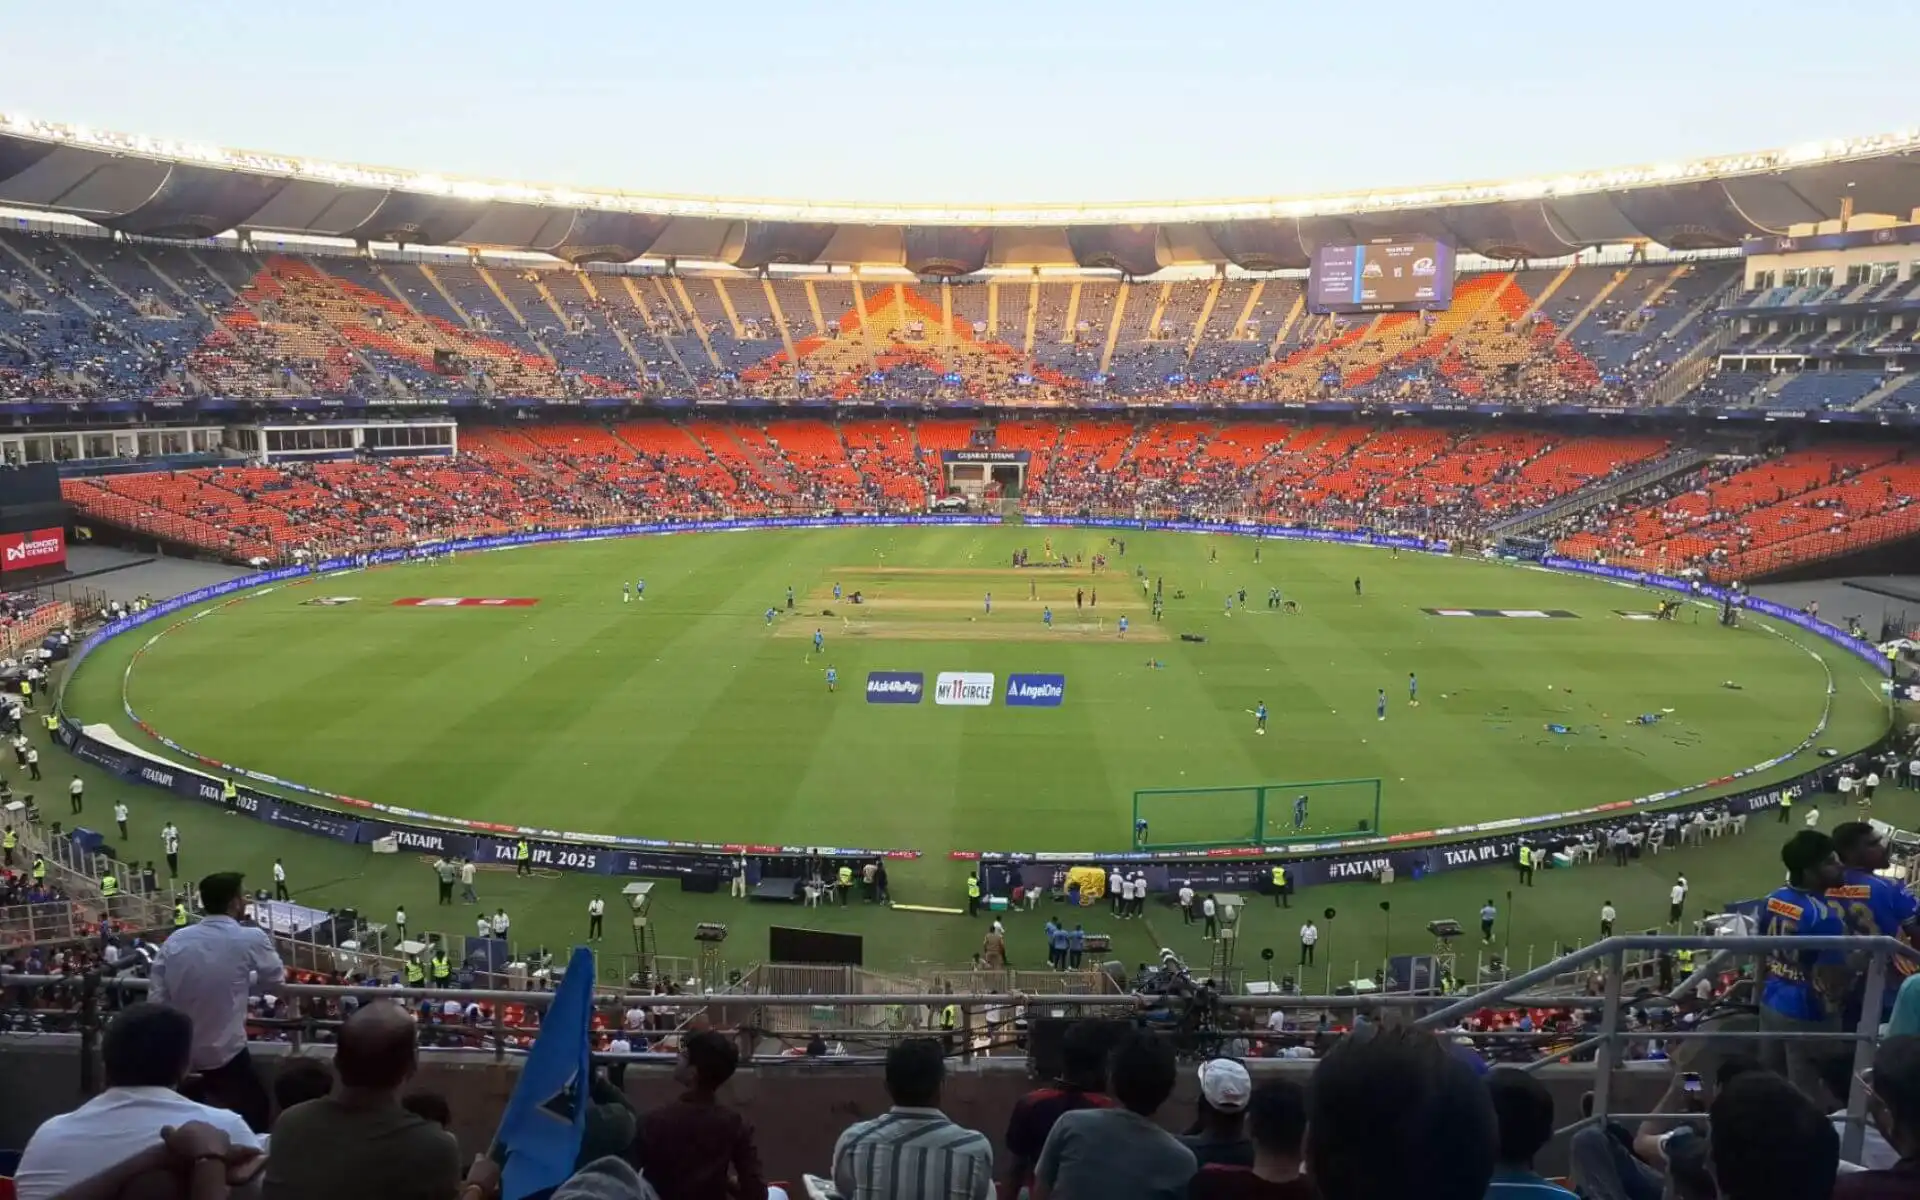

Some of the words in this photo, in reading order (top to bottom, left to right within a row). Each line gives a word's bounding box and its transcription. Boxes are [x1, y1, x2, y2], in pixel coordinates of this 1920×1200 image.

[25, 539, 58, 550] WONDER
[1020, 684, 1062, 698] AngelOne
[200, 784, 218, 800] TATA
[496, 845, 520, 860] TAT
[532, 849, 554, 864] IPL
[557, 852, 596, 868] 2025
[1444, 849, 1478, 864] TATA
[1480, 846, 1499, 860] IPL
